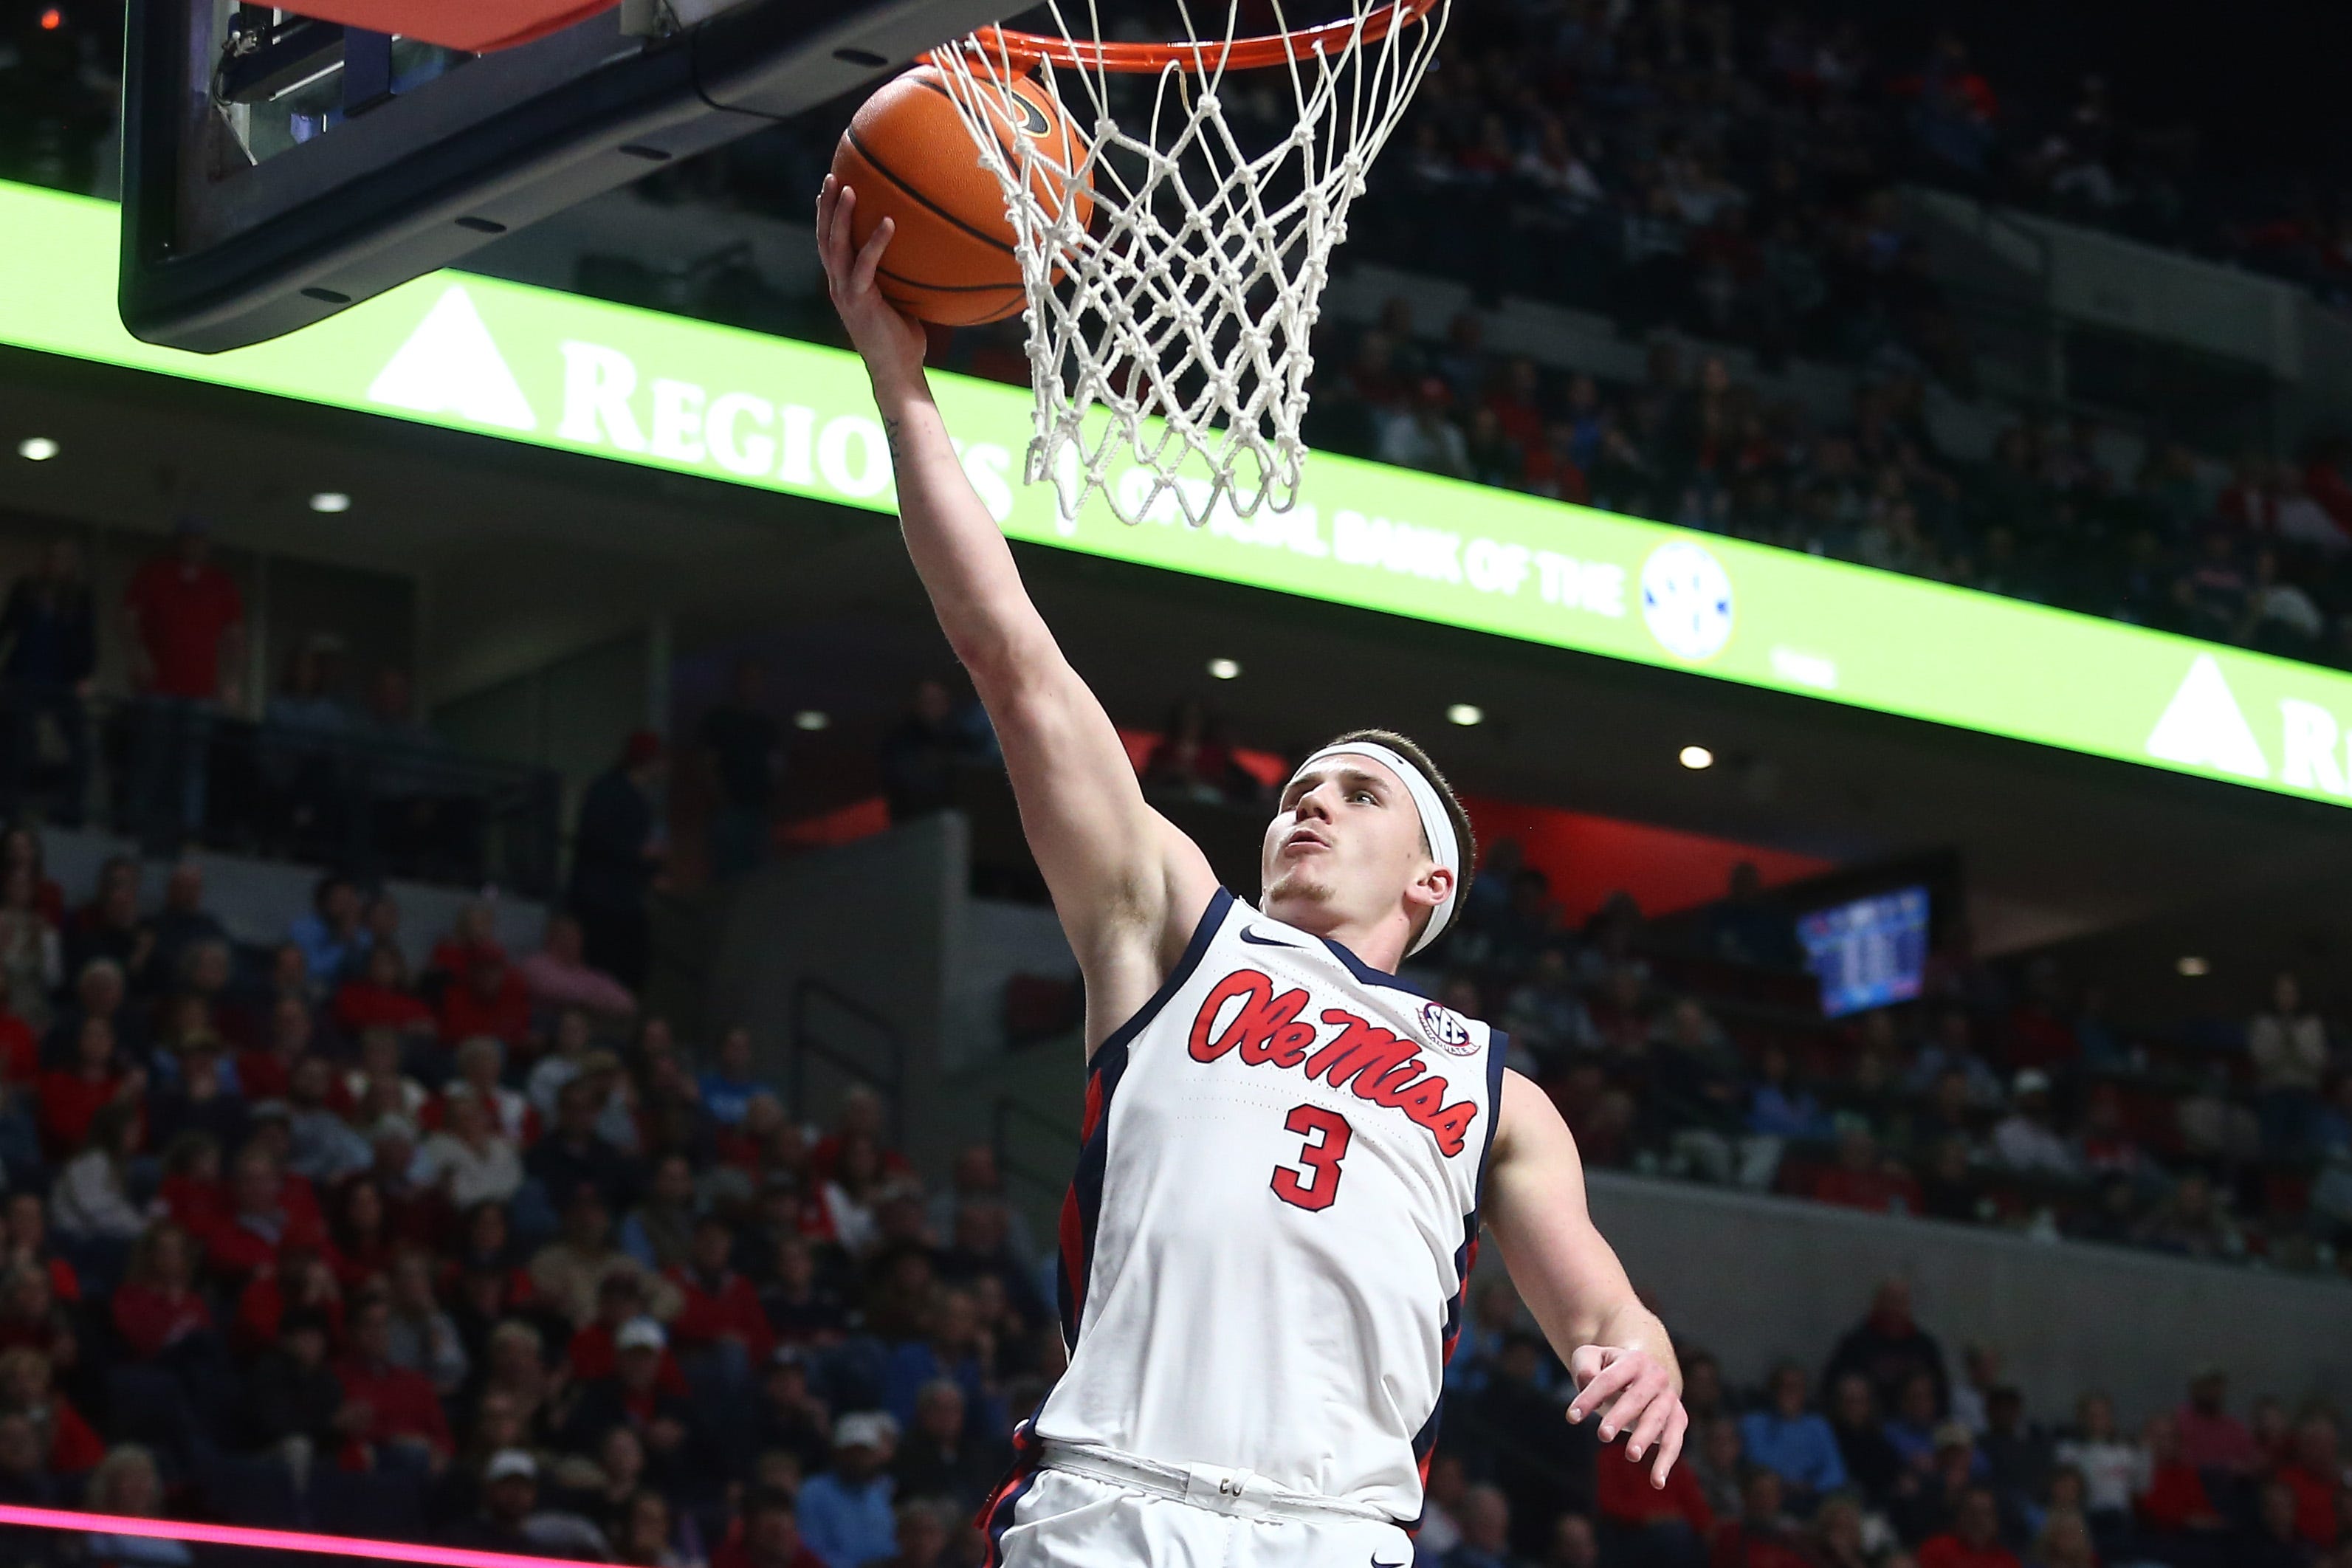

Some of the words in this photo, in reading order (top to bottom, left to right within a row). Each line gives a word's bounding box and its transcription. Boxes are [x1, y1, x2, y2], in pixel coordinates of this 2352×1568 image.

[558, 340, 1013, 524] REGIOS
[1468, 540, 1530, 593] OF
[1536, 553, 1623, 615] THE
[2280, 699, 2352, 796] R
[1188, 969, 1316, 1068] Ole
[1304, 1008, 1477, 1158] Miss
[1426, 1004, 1467, 1044] SEC
[1270, 1103, 1352, 1212] 3
